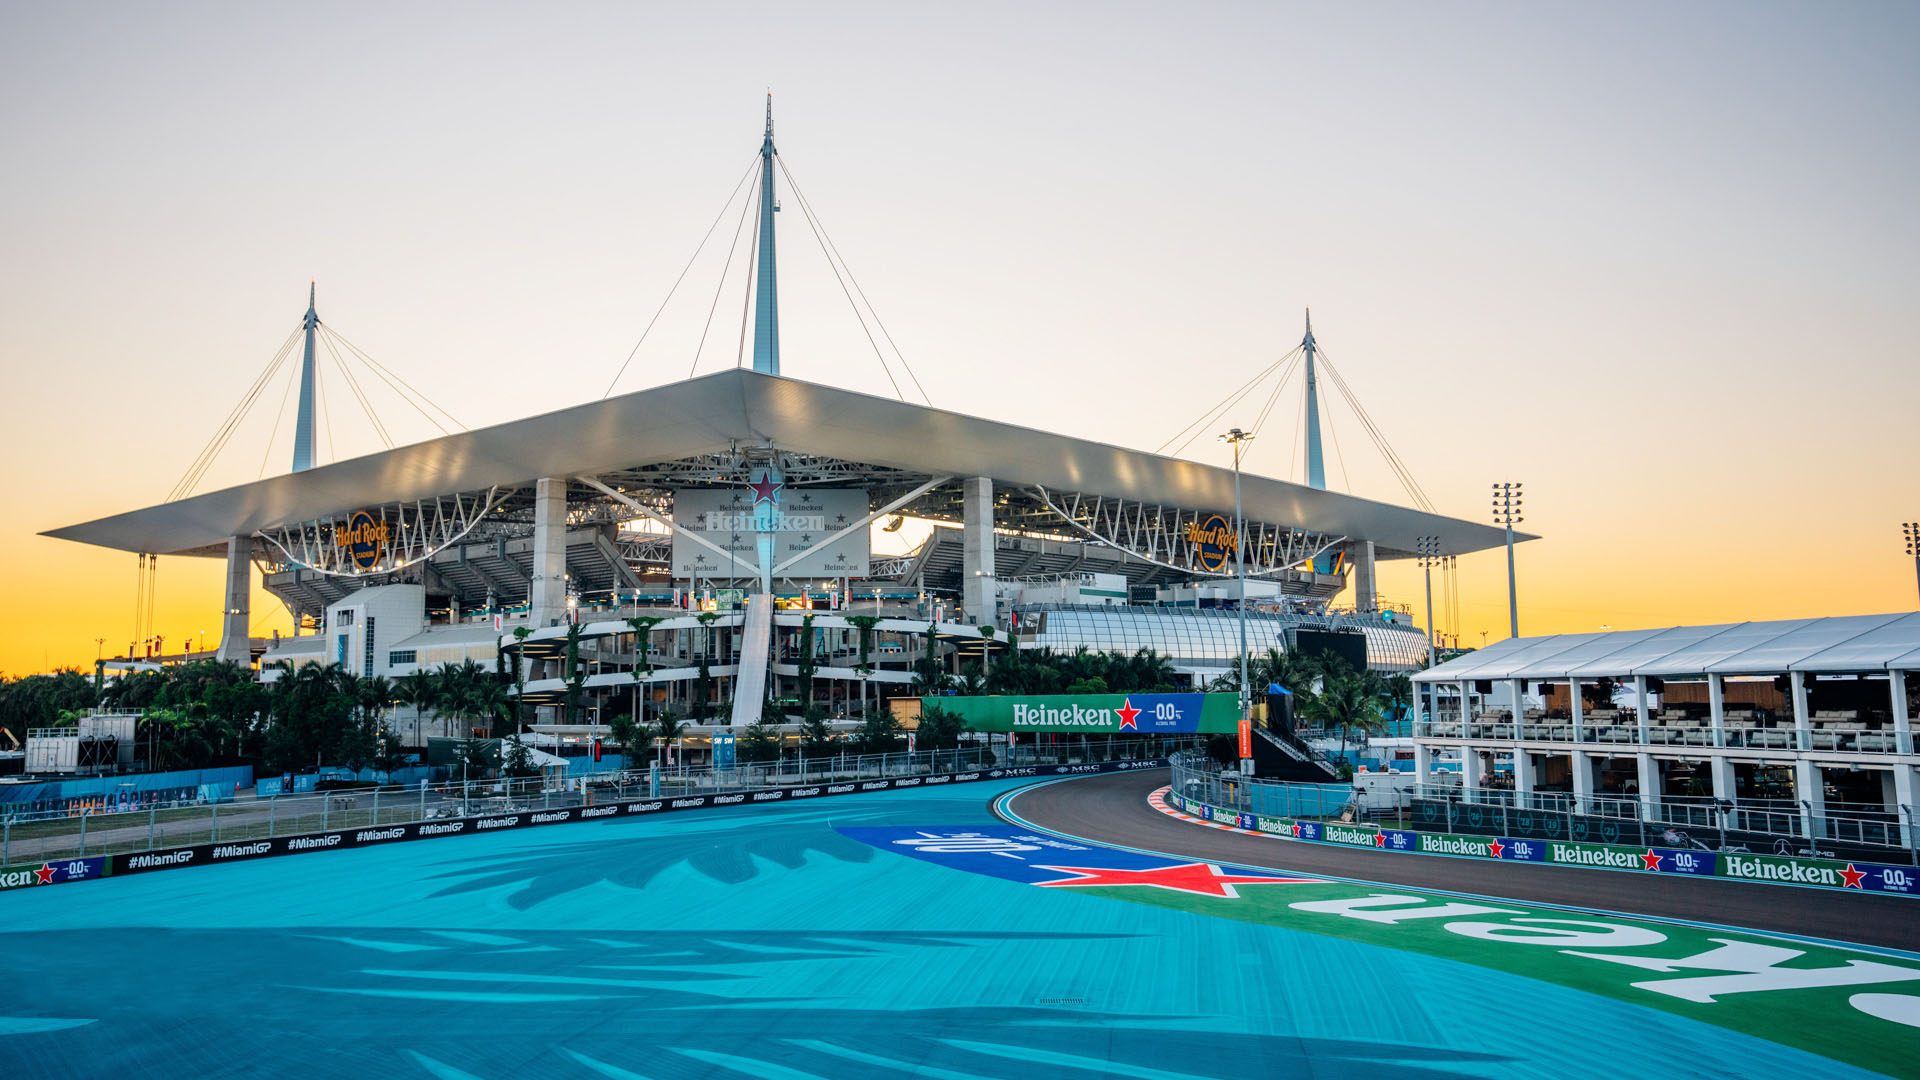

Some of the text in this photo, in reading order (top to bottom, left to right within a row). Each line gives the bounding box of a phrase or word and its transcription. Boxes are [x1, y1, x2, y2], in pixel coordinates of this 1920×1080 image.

[705, 511, 825, 531] Heineken
[337, 520, 390, 547] Hard Rock
[1188, 523, 1217, 544] Hard
[824, 563, 858, 571] Heineen
[1013, 703, 1113, 727] Heineken
[1005, 767, 1036, 776] MSC
[628, 802, 662, 812] #MiamiGP
[672, 798, 704, 808] #MiamiGP
[531, 811, 570, 823] #MiamiGP
[581, 806, 617, 818] #MiamiGP
[419, 822, 464, 836] #MiamiGP
[476, 816, 518, 830] #MiamiGP
[1258, 817, 1292, 835] Heineken
[287, 834, 341, 850] #MiamiGP
[356, 827, 405, 842] #MiamiGP
[1325, 826, 1374, 846] Heineken
[212, 842, 271, 859] #MiamiGP
[1422, 835, 1487, 856] Heineken
[129, 850, 194, 869] #MiamiGP
[1552, 844, 1640, 868] Heineken
[0, 870, 32, 888] ken
[1725, 856, 1837, 885] Heineken
